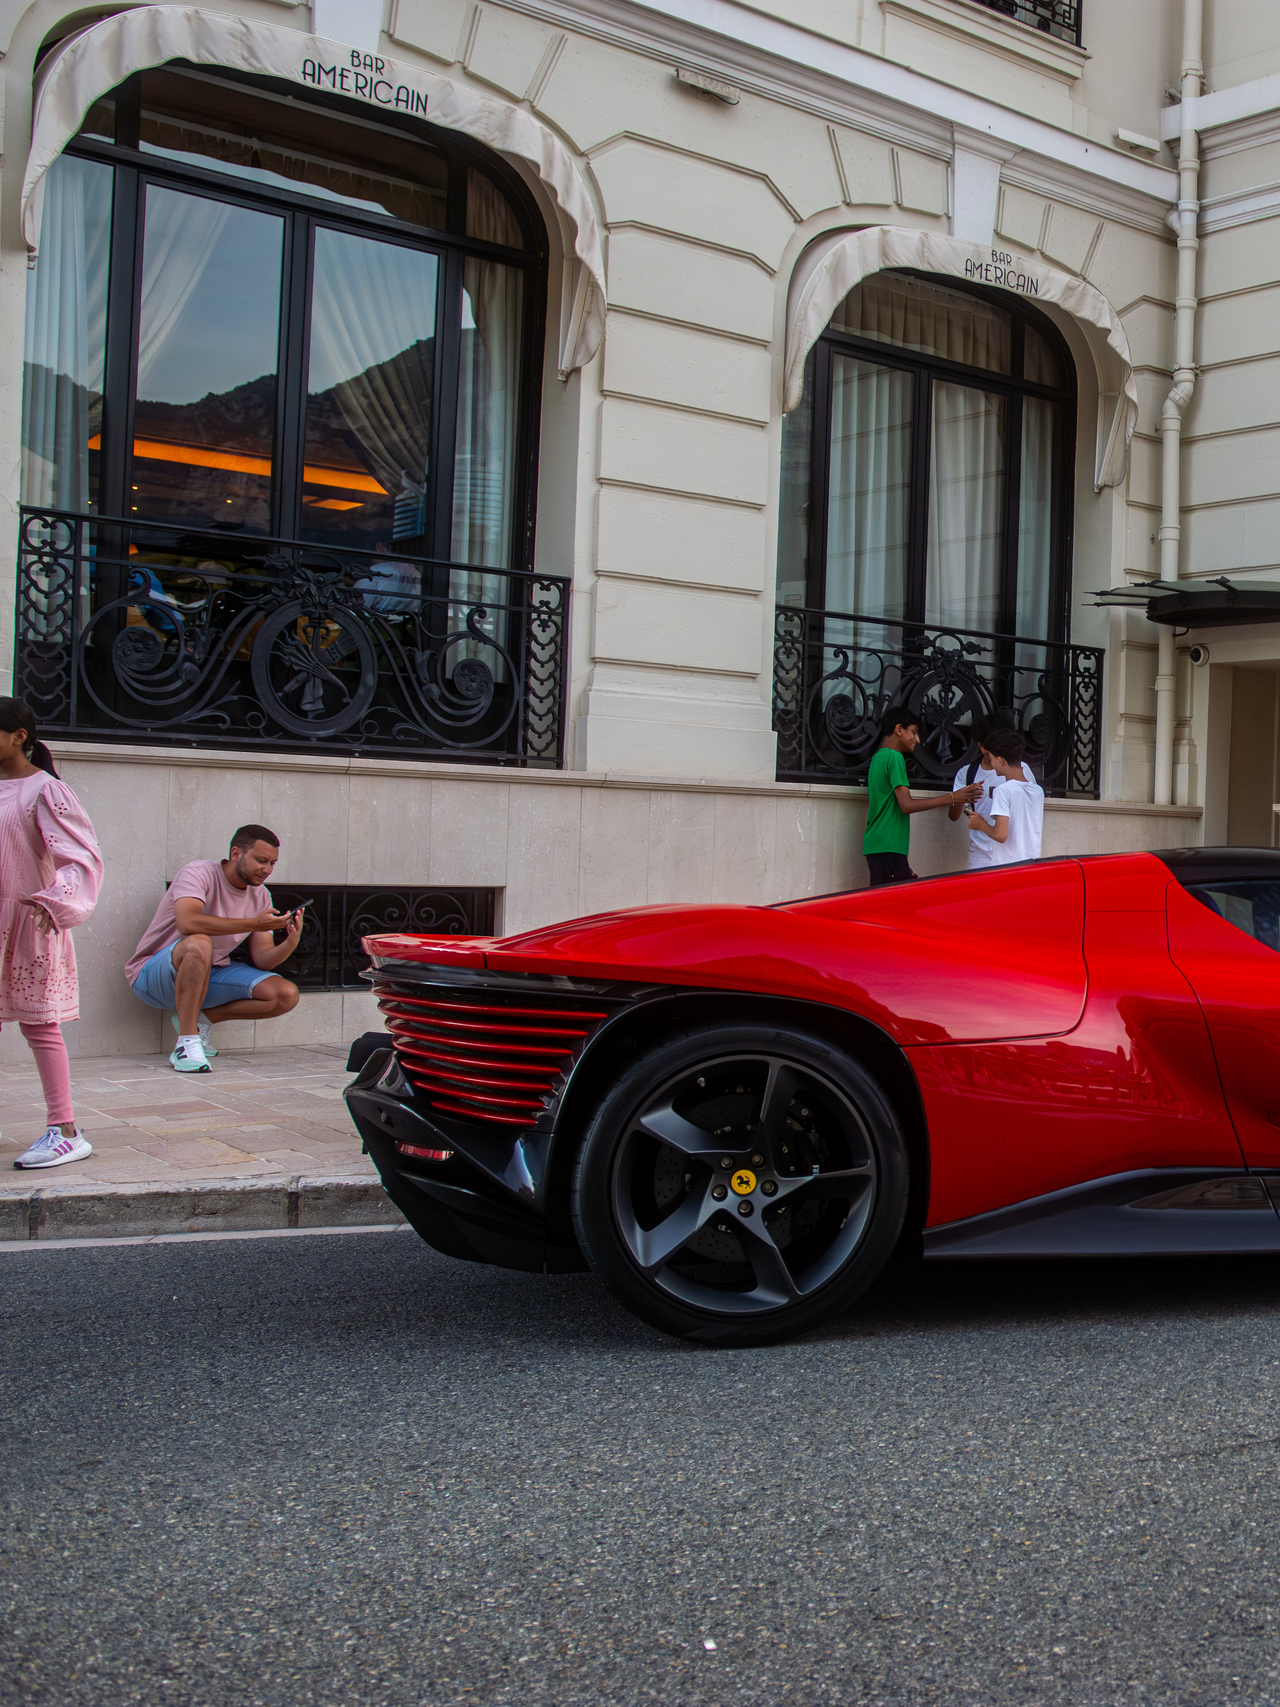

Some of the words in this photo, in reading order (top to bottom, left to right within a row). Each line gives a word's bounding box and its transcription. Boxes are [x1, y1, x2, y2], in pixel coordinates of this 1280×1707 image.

[350, 50, 385, 76] BAR
[301, 59, 428, 116] AMERICAIN
[991, 249, 1012, 267] BAR
[964, 258, 1039, 295] AMERICAIN
